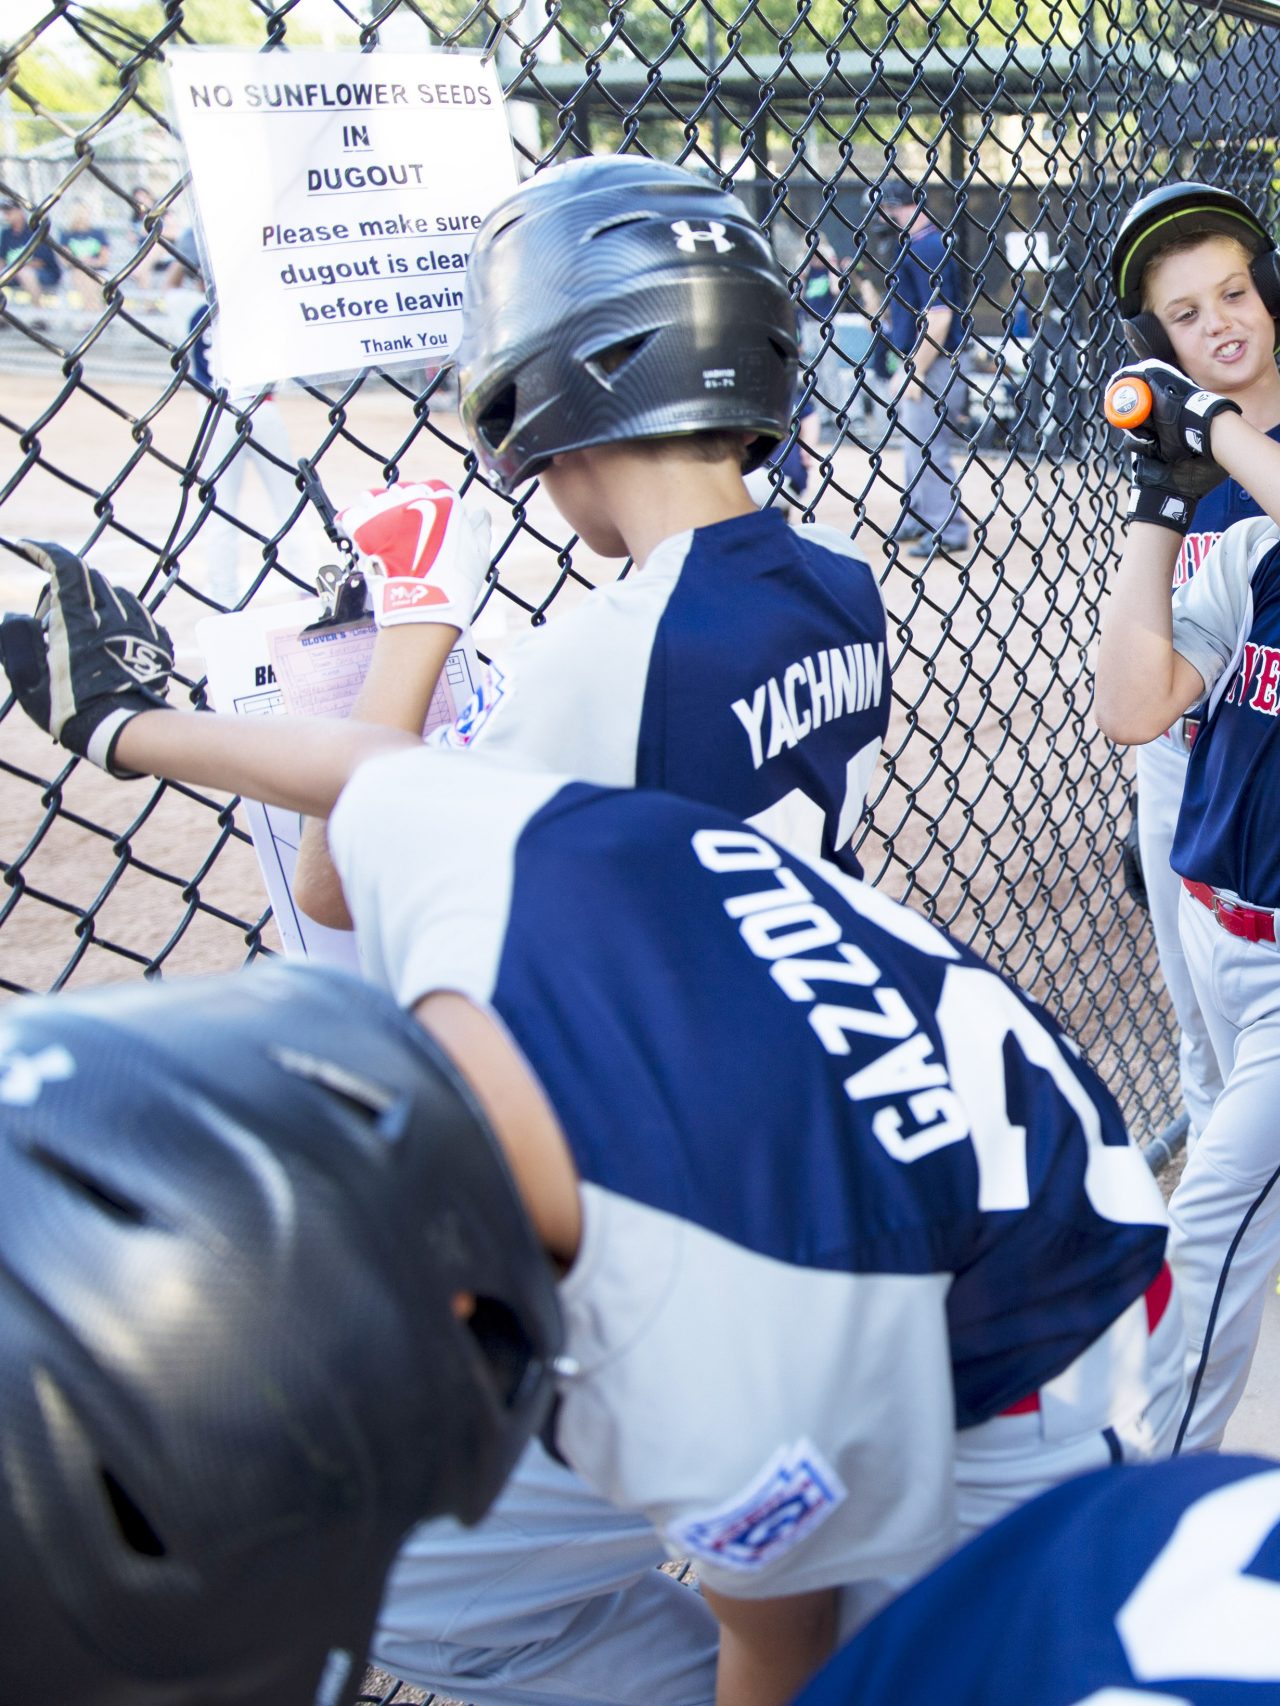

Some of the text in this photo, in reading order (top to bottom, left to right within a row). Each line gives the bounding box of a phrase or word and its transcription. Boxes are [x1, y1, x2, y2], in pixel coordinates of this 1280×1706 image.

[190, 83, 492, 107] NO SUNFLOWER SEEDS
[342, 125, 370, 147] IN
[308, 164, 424, 191] DUGOUT
[262, 214, 482, 246] Please make sure
[280, 255, 380, 285] dugout
[387, 253, 409, 274] is
[299, 287, 464, 322] before leavin
[360, 332, 448, 353] Thank You
[730, 642, 885, 770] YACHNIN
[691, 829, 970, 1164] GAZZOLO
